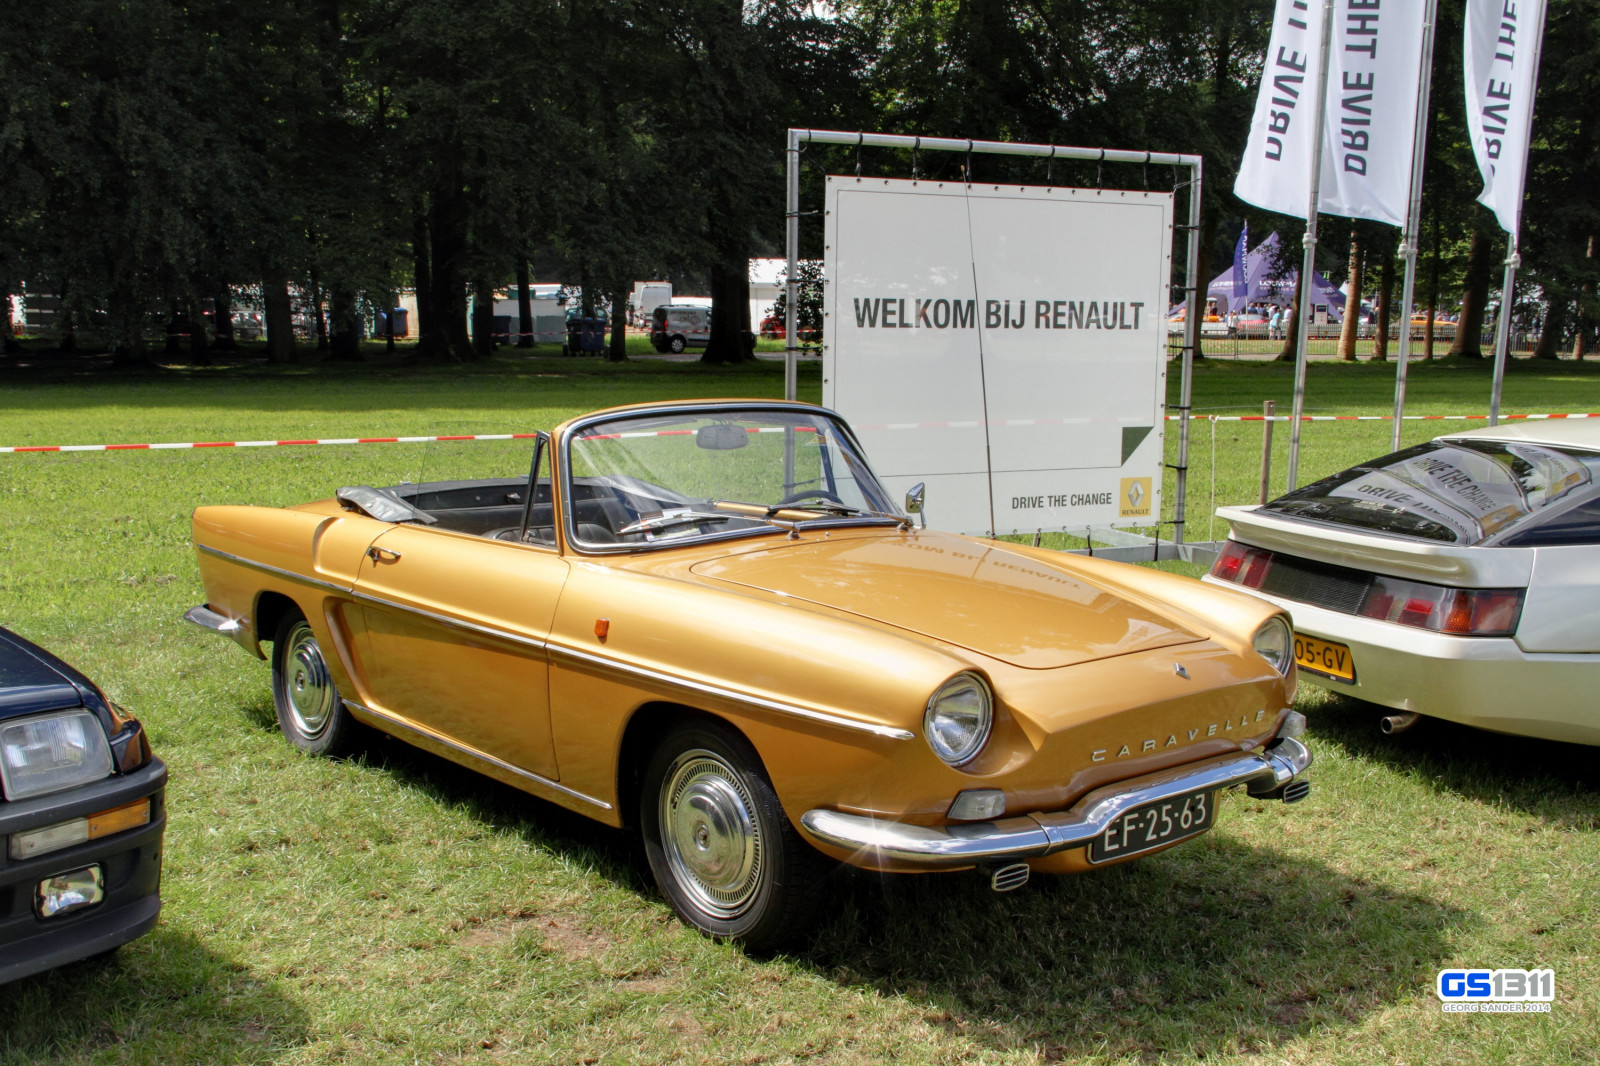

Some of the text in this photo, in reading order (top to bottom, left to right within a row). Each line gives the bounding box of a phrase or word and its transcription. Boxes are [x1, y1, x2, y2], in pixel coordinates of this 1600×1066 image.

[853, 298, 1145, 331] WELKOM BIJ RENAULT
[1012, 492, 1112, 509] DRIVE THE CHANGE
[1121, 508, 1150, 516] RENAULT
[1092, 710, 1264, 762] CARAVELLE
